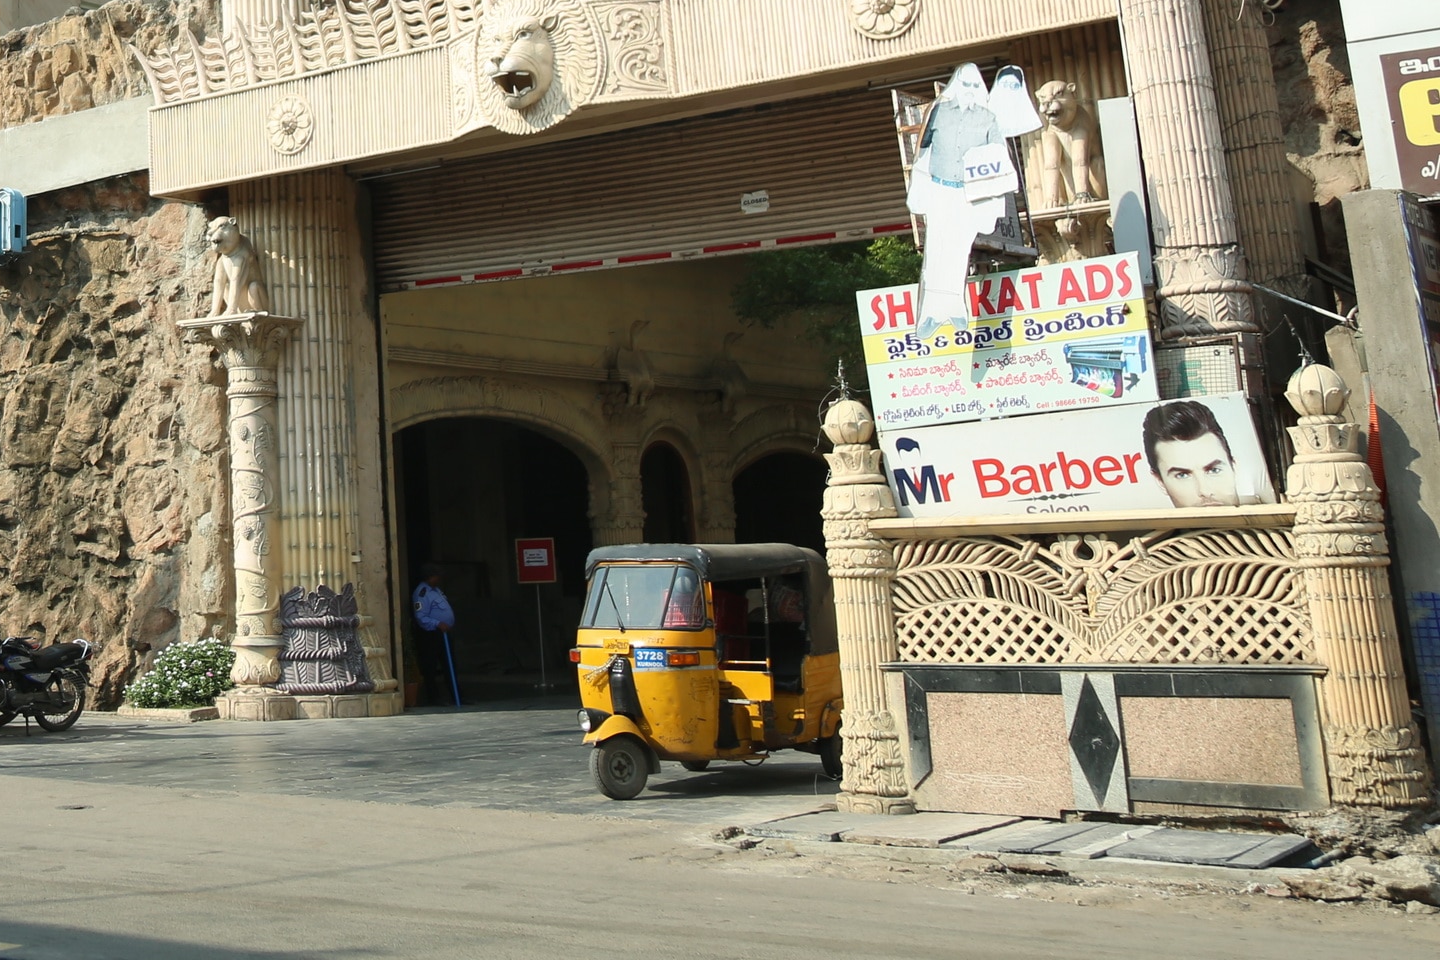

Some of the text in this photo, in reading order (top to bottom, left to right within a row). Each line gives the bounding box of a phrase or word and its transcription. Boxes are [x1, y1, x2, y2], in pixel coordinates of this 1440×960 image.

[965, 161, 1001, 179] TGV
[743, 197, 767, 206] CLOSED
[870, 259, 1133, 331] SHKAT ADS
[954, 319, 1013, 350] వినైల్
[951, 403, 967, 414] LED
[1035, 401, 1052, 410] Cell
[1055, 398, 1077, 408] 98666
[1078, 396, 1100, 405] 19750
[972, 451, 1142, 499] Barber
[893, 464, 955, 507] Mr
[636, 650, 664, 661] 3728
